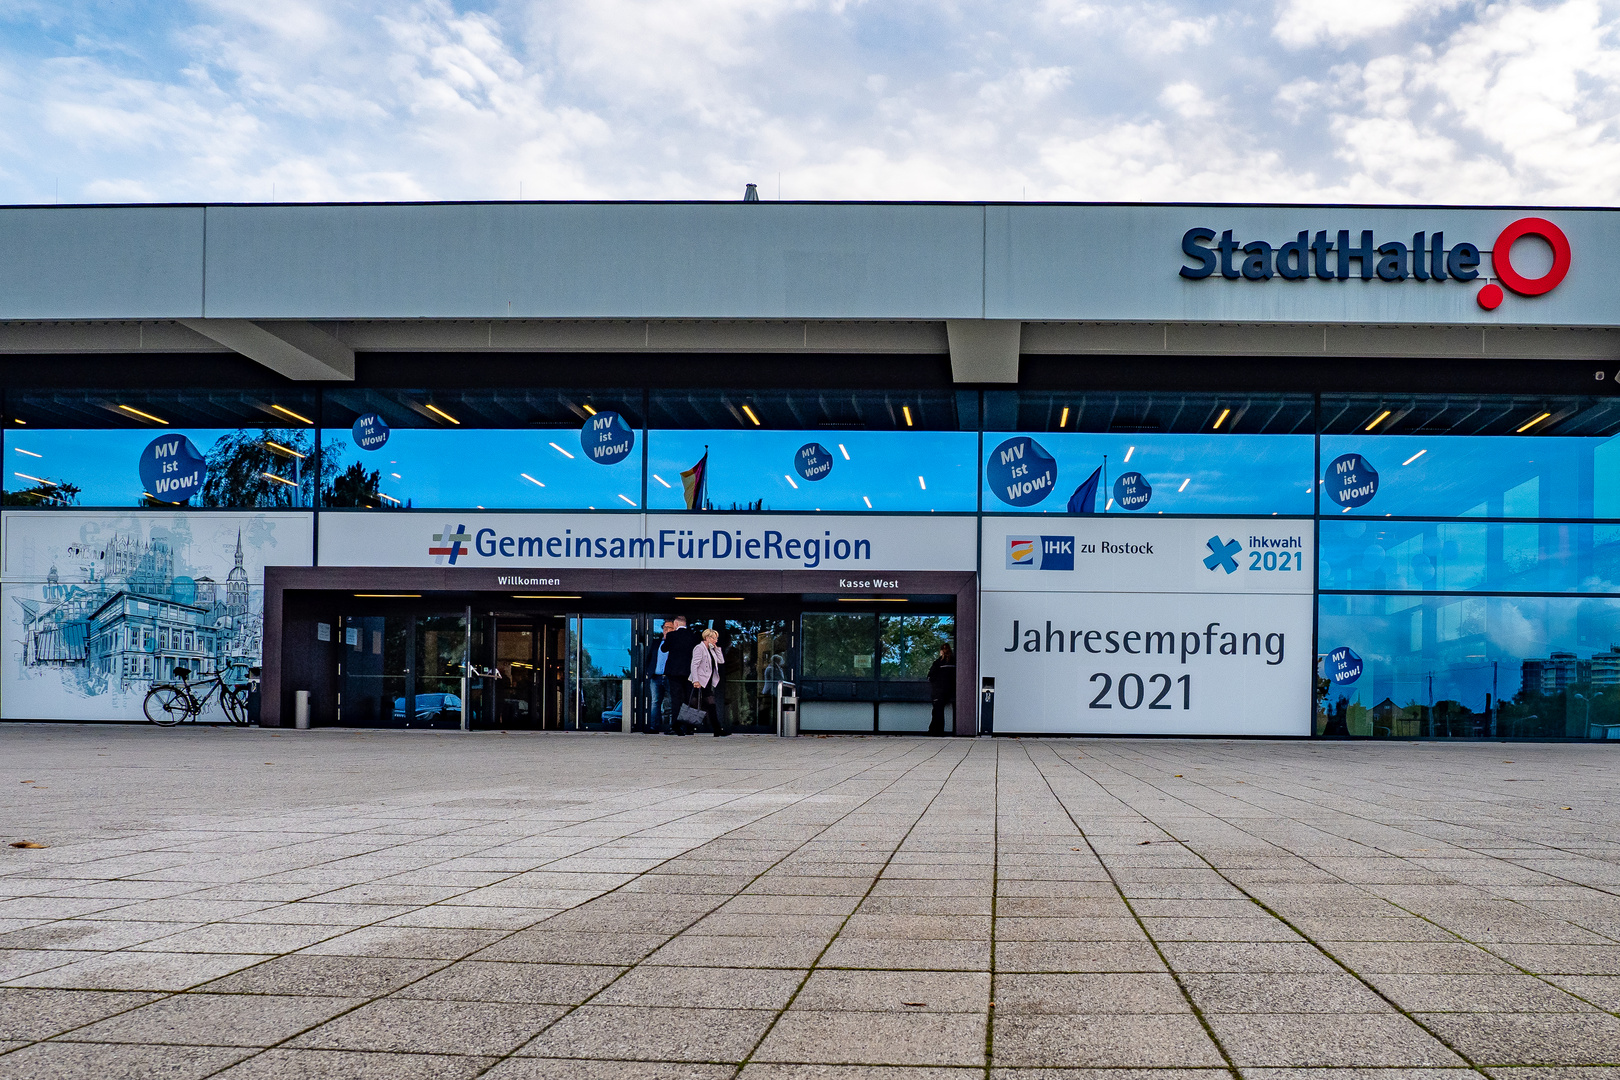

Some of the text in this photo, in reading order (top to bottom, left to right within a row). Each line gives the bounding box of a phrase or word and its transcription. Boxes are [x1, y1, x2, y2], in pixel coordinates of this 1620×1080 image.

[1178, 227, 1481, 281] StadtHalle
[360, 416, 375, 428] MV
[593, 416, 613, 431] MV
[361, 433, 387, 446] Wow!
[600, 432, 612, 442] ist
[154, 441, 179, 459] MV
[594, 441, 628, 458] Wow!
[801, 446, 816, 459] MV
[1001, 444, 1024, 464] MV
[162, 460, 178, 473] ist
[808, 457, 818, 466] ist
[1336, 459, 1355, 474] MV
[805, 462, 831, 478] Wow!
[1012, 463, 1028, 478] ist
[155, 471, 199, 494] Wow!
[1007, 471, 1051, 499] Wow!
[1122, 476, 1137, 486] MV
[1343, 474, 1357, 485] ist
[1127, 486, 1137, 494] ist
[1339, 482, 1374, 501] Wow!
[1122, 492, 1148, 506] Wow!
[1045, 541, 1072, 553] IHK
[1080, 541, 1154, 554] zu Rostock
[1249, 536, 1302, 549] ihkwahl
[1249, 551, 1302, 571] 2021
[497, 576, 561, 586] Willkommen
[839, 578, 899, 589] Kasse West
[1004, 620, 1286, 666] Jahresempfang
[1331, 650, 1346, 662] MV
[1338, 661, 1348, 669] ist
[1335, 666, 1361, 682] Wow!
[1088, 672, 1191, 711] 2021
